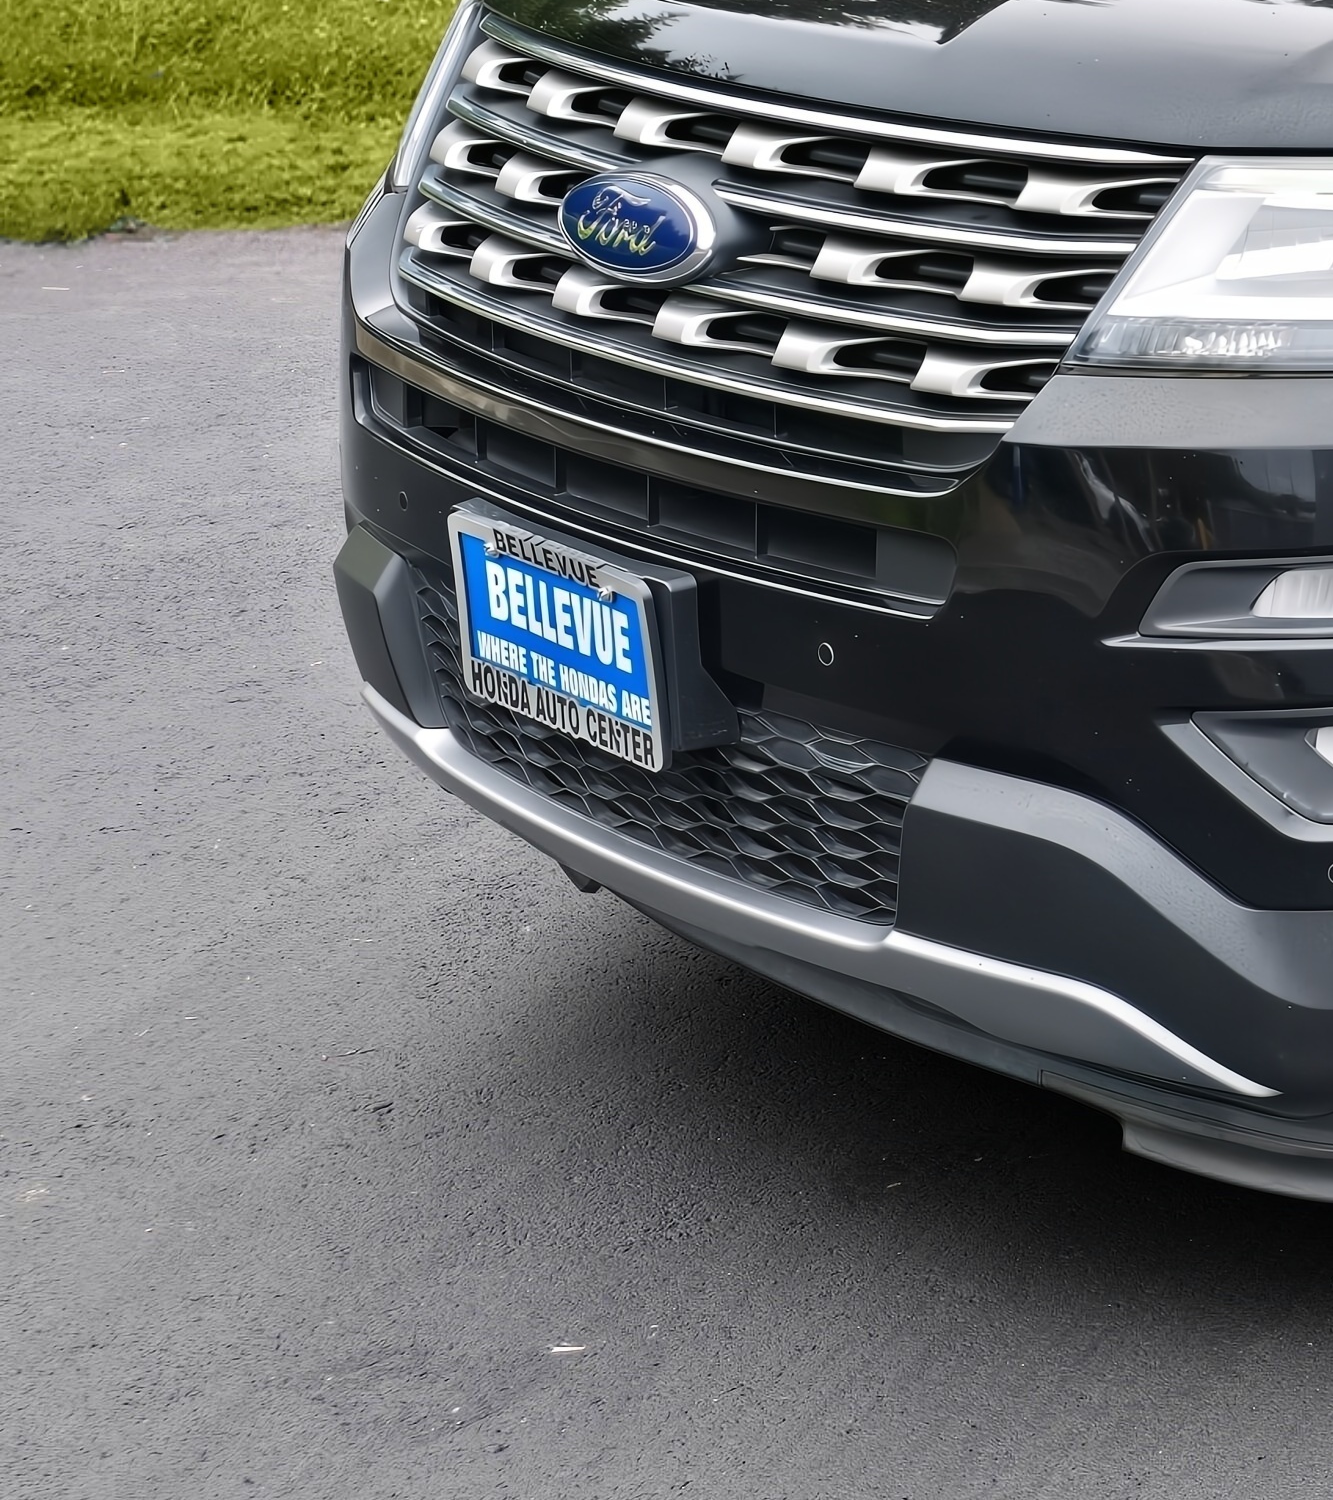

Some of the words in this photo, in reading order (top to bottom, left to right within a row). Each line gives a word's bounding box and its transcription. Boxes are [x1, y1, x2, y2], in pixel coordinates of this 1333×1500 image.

[577, 185, 666, 257] Ford
[493, 528, 600, 587] BELLEVUE
[485, 559, 633, 674] BELLEVUE
[470, 660, 532, 714] HONDA
[536, 686, 580, 736] AUTO
[586, 707, 656, 769] CENTER
[476, 630, 528, 675] WHERE
[530, 655, 557, 687] THE
[560, 666, 618, 713] HONDAS
[621, 690, 652, 726] ARE
